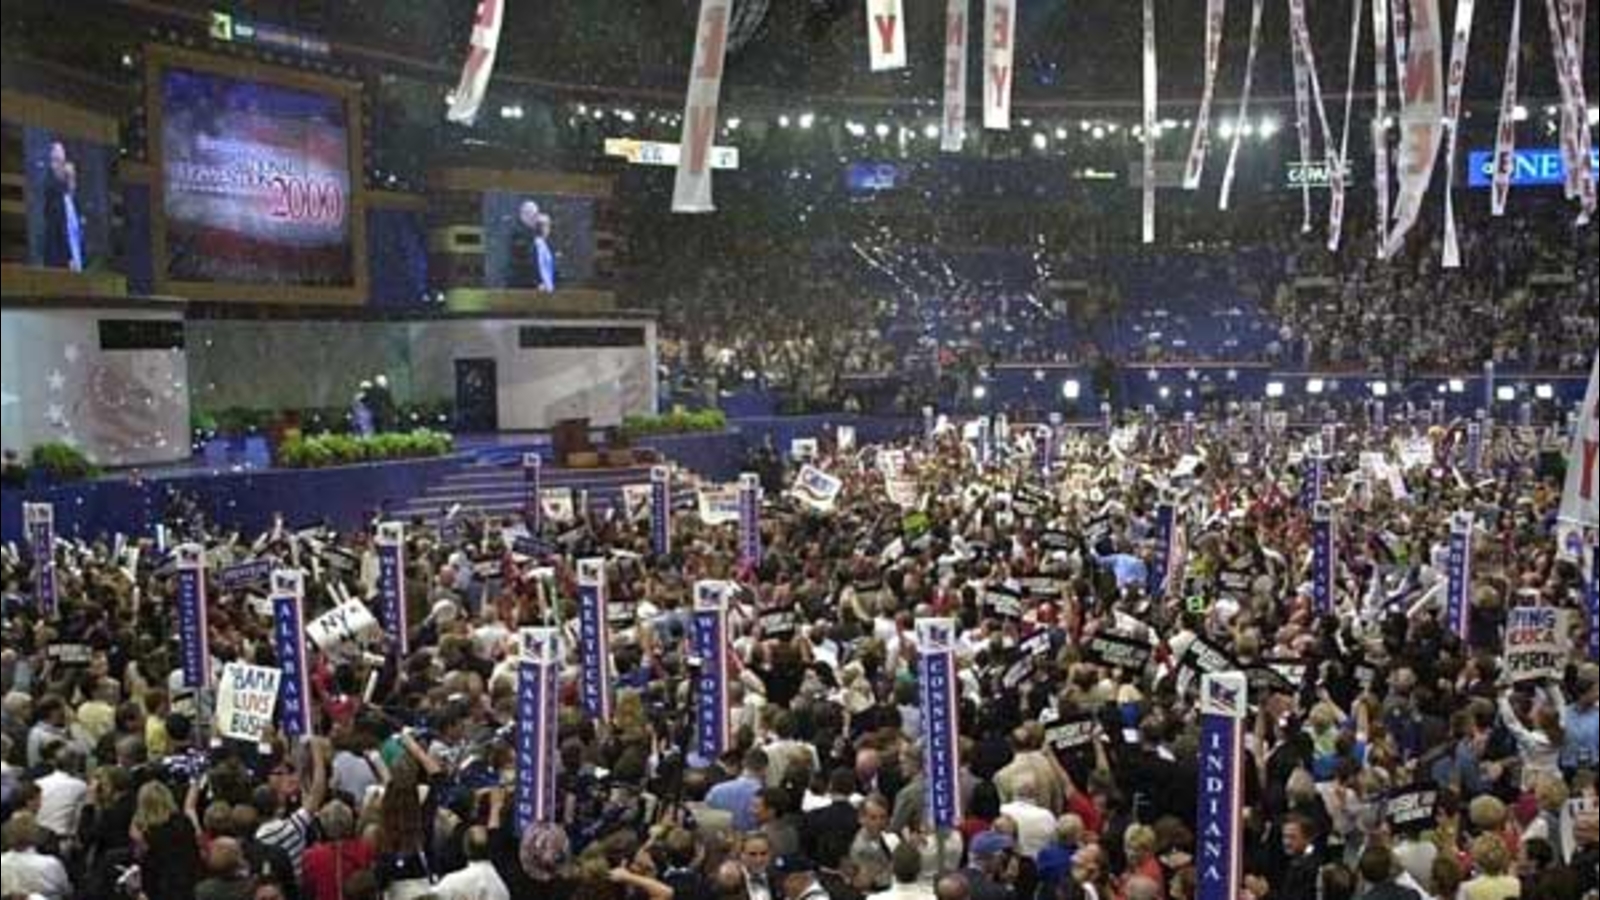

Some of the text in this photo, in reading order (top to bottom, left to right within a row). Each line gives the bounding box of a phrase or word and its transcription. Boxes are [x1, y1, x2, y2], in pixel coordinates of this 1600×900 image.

[268, 176, 343, 223] 2000
[279, 601, 300, 732] ALABAMA
[583, 595, 598, 710] KENTUCKY
[700, 617, 715, 751] WISONSIN
[519, 670, 535, 827] WASHINGTON
[930, 661, 948, 821] CONNECTICUT
[1204, 732, 1223, 880] INDIANA
